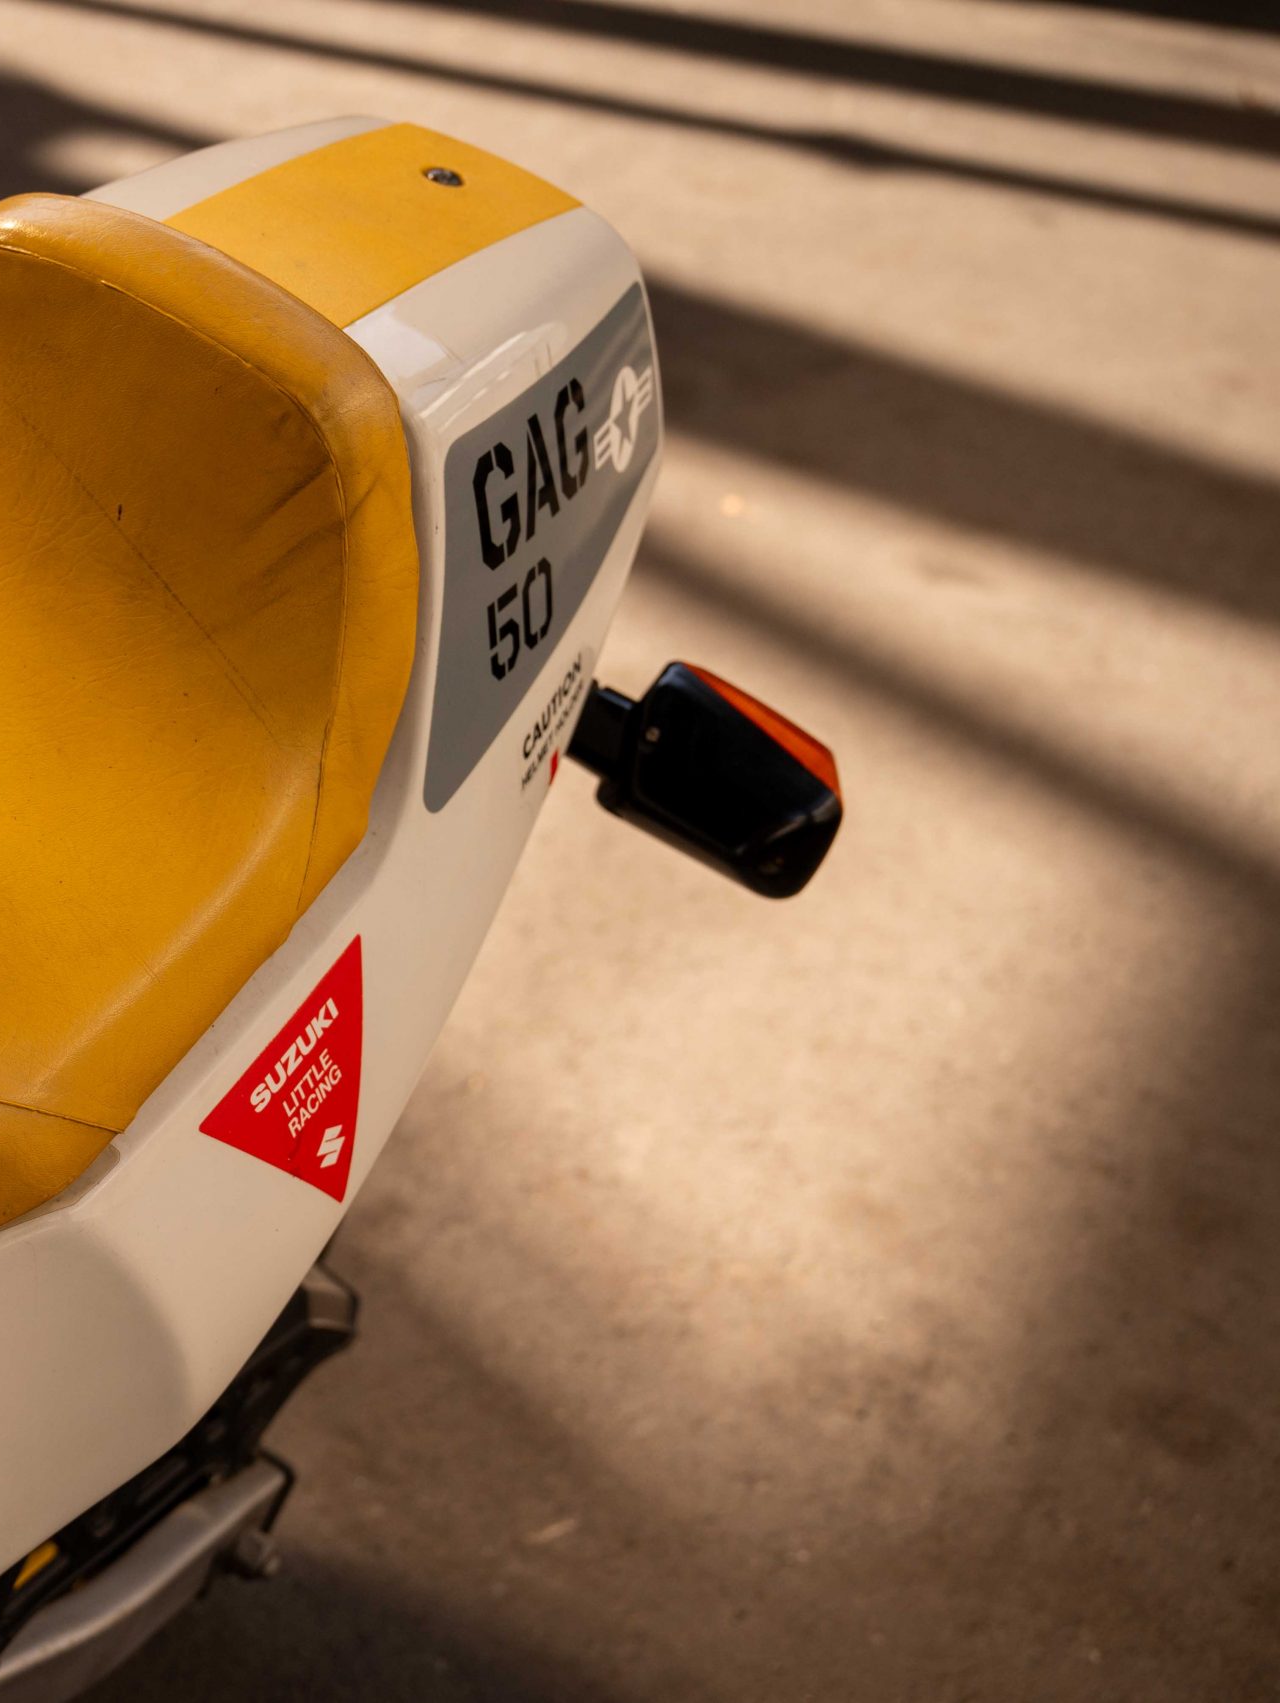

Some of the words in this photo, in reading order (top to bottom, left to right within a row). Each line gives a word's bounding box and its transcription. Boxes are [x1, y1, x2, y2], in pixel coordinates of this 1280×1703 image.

[472, 377, 590, 571] GAG
[486, 556, 553, 682] 50
[523, 651, 582, 760] CAUTION
[249, 997, 340, 1113] SUZUKI
[282, 1048, 333, 1117] LITTLE
[287, 1064, 343, 1139] RACING
